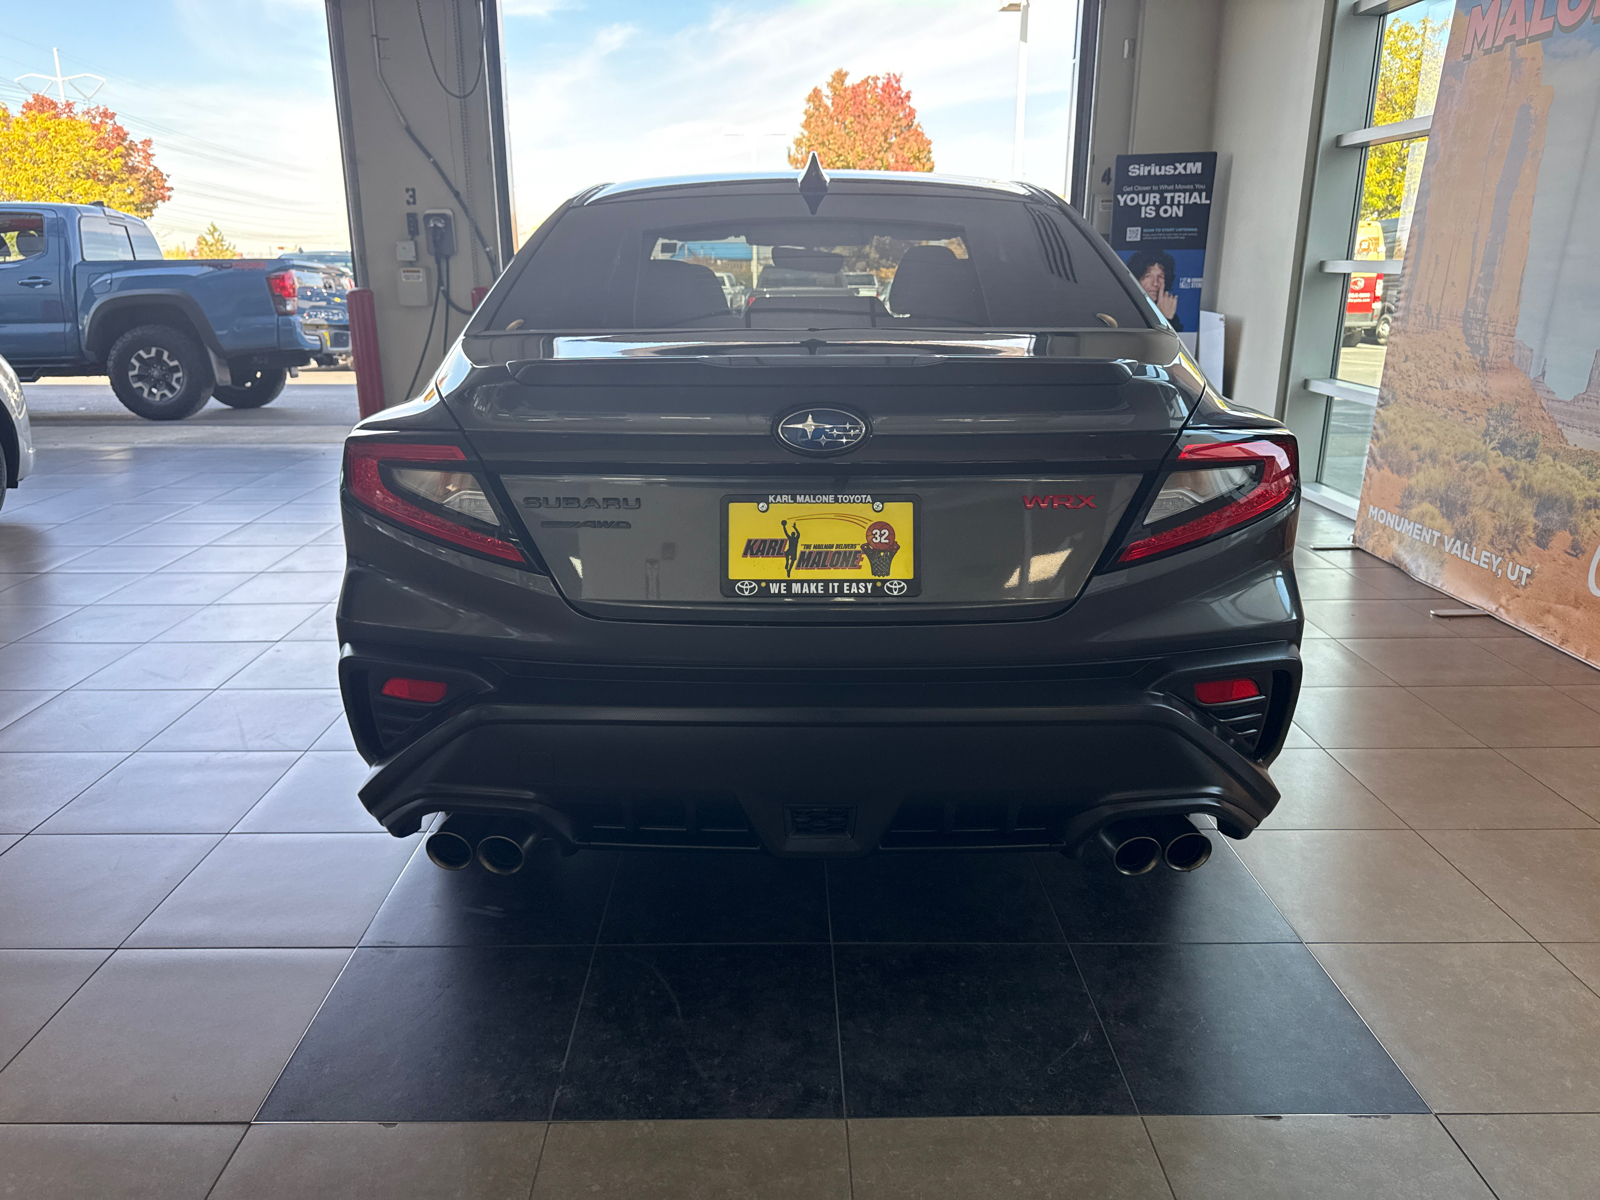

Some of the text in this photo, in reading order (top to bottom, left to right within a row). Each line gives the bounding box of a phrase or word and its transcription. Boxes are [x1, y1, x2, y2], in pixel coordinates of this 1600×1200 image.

[1462, 0, 1600, 60] MALO
[1101, 166, 1112, 186] 4
[1128, 162, 1202, 177] SiriusXM
[405, 187, 417, 206] 3
[1117, 193, 1161, 206] YOUR
[1163, 191, 1211, 205] TRIAL
[1140, 204, 1184, 218] IS ON
[522, 496, 642, 510] SUBARU
[768, 494, 873, 503] KARL MALONE TOYOTA
[1023, 494, 1097, 510] WRX
[574, 520, 632, 529] AWD
[872, 529, 890, 543] 32
[742, 538, 788, 558] KARL
[1368, 504, 1532, 586] MONUMENT VALLEY, UT
[795, 550, 864, 570] MALONE
[769, 582, 873, 594] WE MAKE IT EASY
